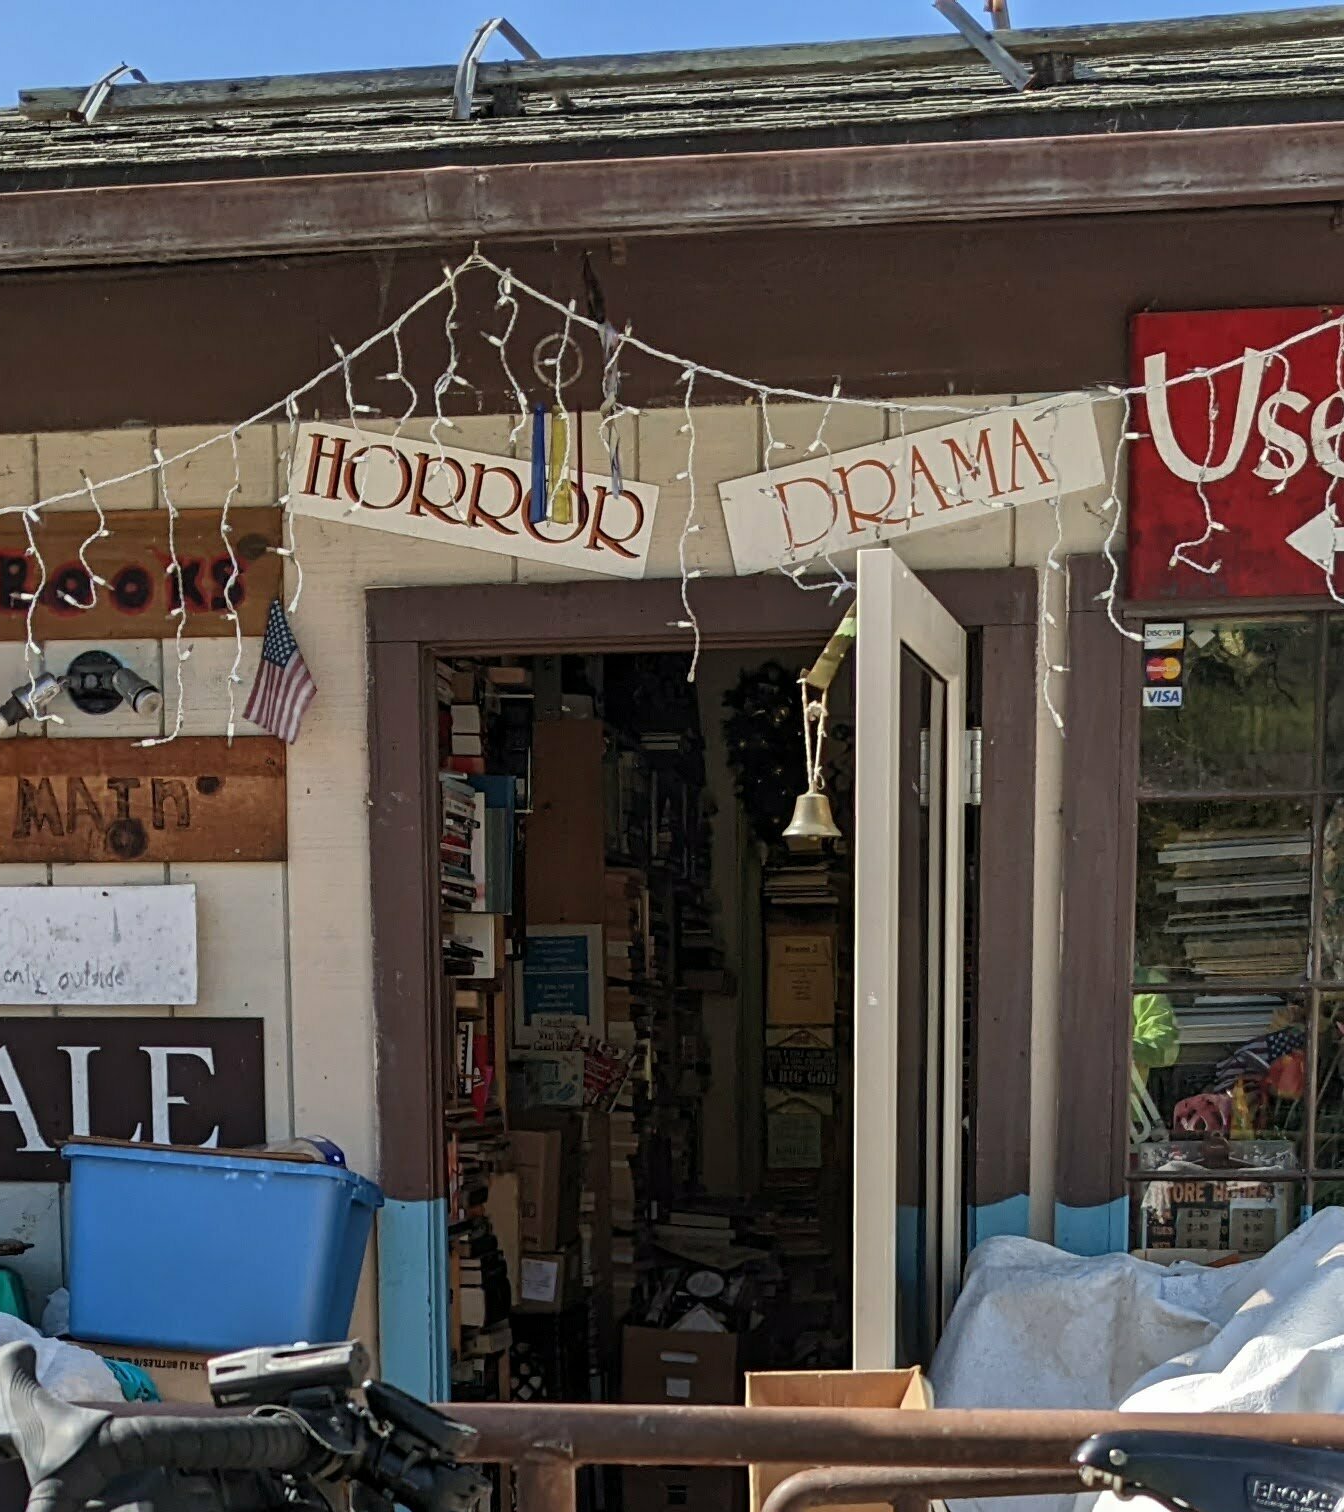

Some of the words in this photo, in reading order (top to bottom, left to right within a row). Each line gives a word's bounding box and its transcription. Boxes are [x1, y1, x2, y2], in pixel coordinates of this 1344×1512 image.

[299, 432, 644, 559] HORROR
[776, 418, 1054, 550] DRAMA
[1147, 690, 1180, 703] VISA
